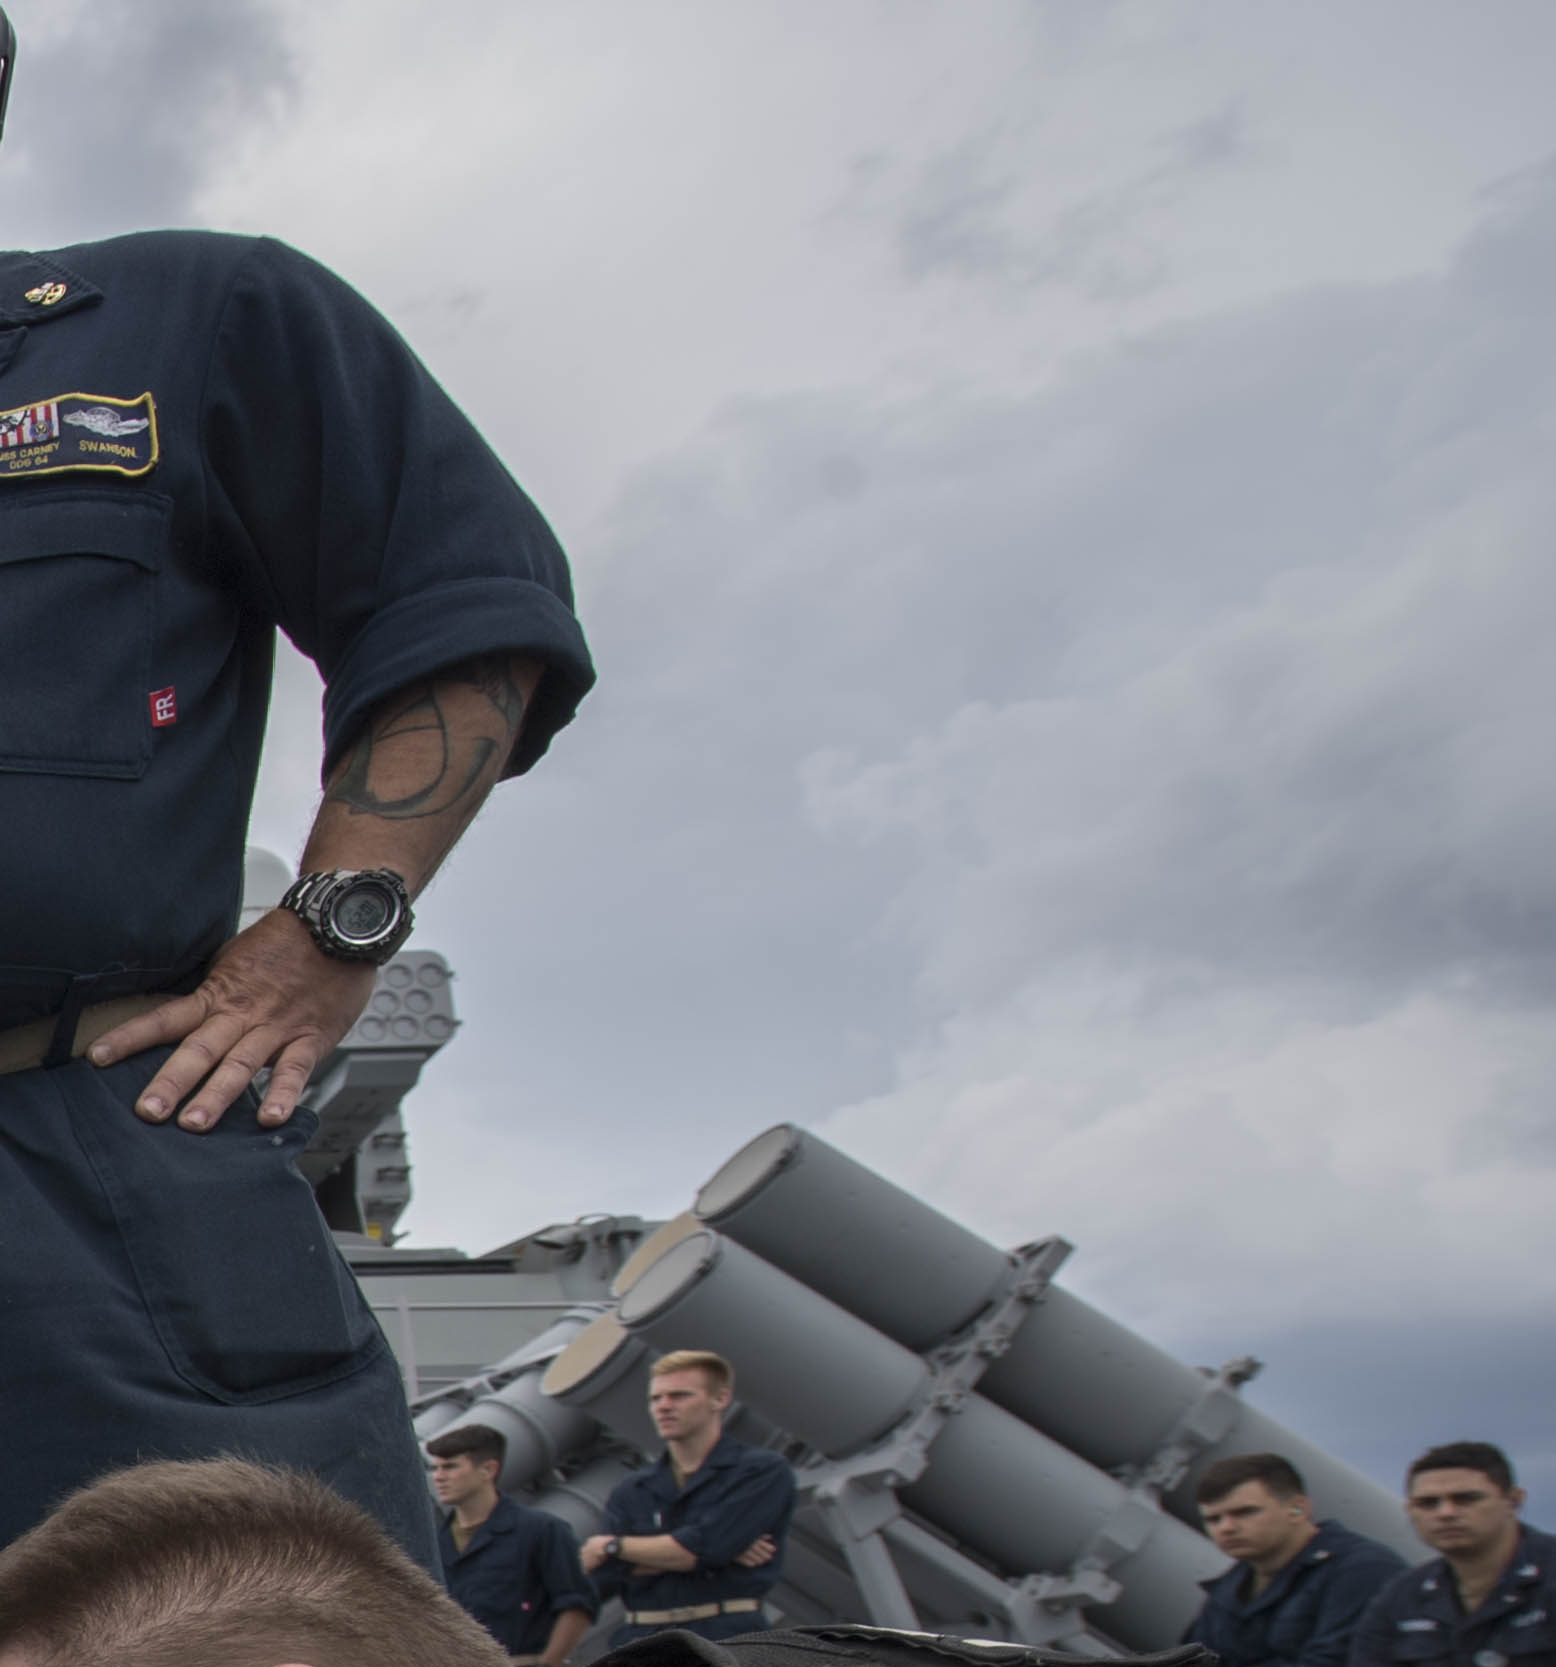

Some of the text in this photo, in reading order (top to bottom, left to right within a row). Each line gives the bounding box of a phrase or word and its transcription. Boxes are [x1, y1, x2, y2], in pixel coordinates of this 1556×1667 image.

[19, 441, 60, 457] CARNEY
[79, 440, 136, 458] SWANSON
[155, 693, 175, 721] FR
